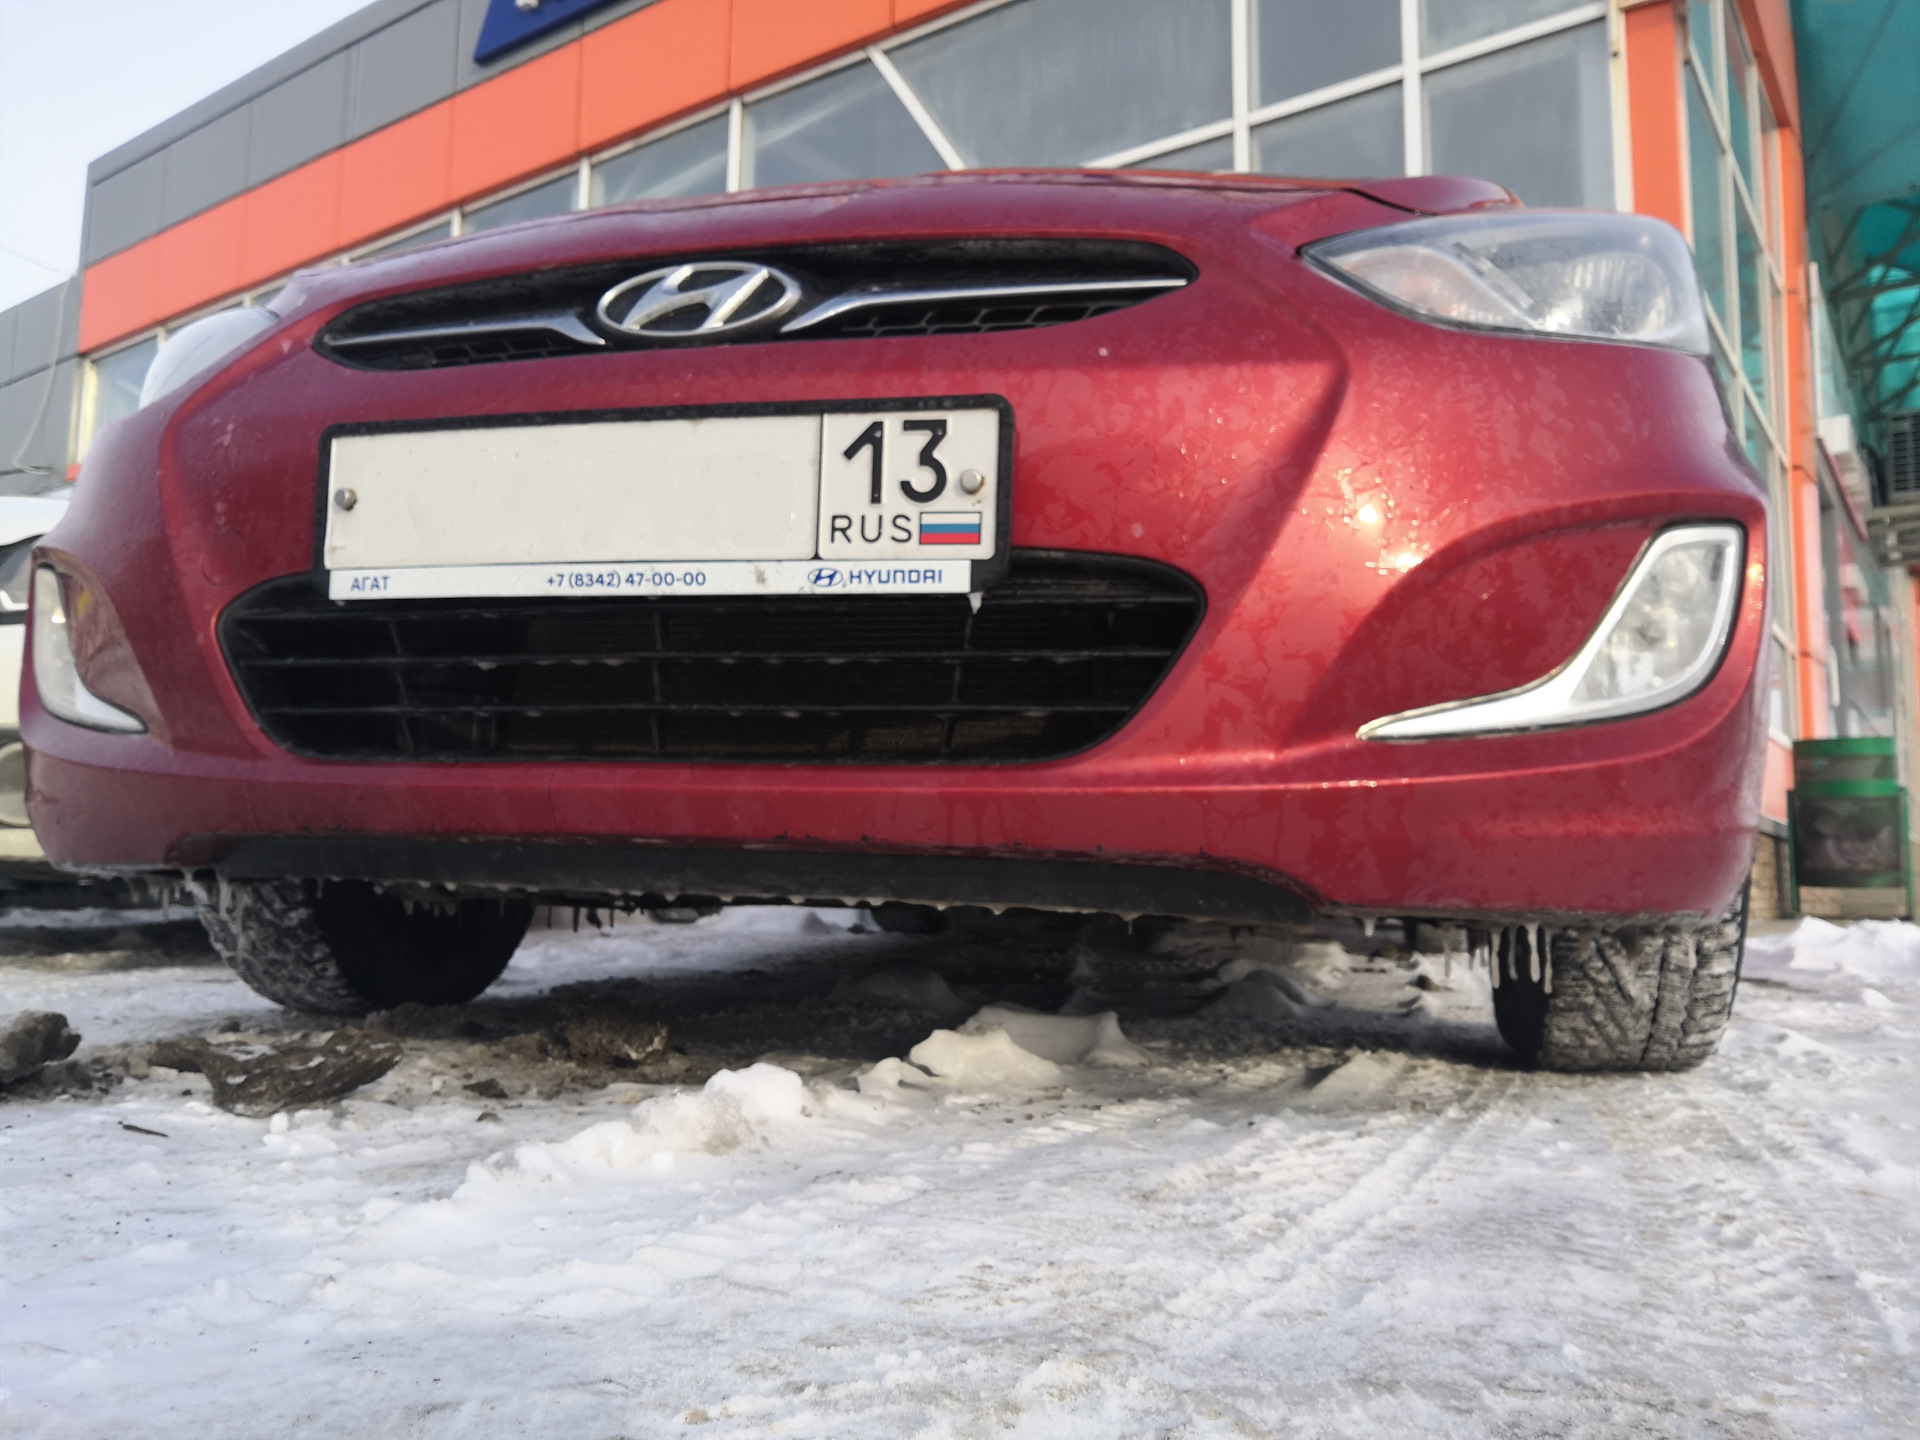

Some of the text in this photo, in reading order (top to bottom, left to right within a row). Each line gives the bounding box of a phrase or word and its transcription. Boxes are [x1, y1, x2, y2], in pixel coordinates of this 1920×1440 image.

[843, 419, 947, 503] 13
[831, 514, 912, 543] RUS
[350, 575, 391, 592] АГАТ
[547, 571, 706, 589] +7 (8342) 47-00-00
[850, 569, 942, 584] HYUNDAI
